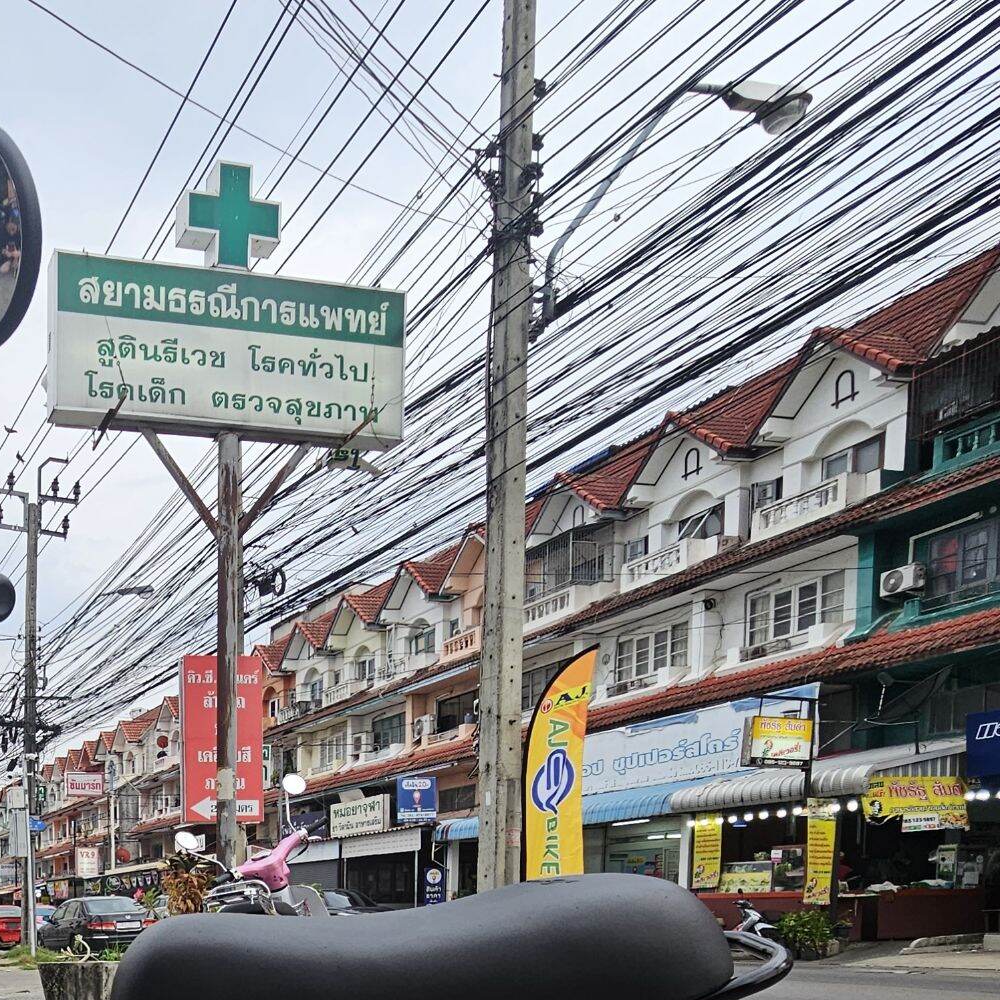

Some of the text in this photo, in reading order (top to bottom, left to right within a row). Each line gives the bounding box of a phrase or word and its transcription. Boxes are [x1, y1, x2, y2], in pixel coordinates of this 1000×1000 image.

[78, 276, 390, 337] สยามธรณีการแพทย์
[97, 334, 369, 383] สูตินรีเวช โรคทั่วไป
[84, 370, 380, 426] โรคเด็ก ตรวจสุขภาพ
[547, 719, 571, 748] AJ
[540, 816, 561, 876] BIKE
